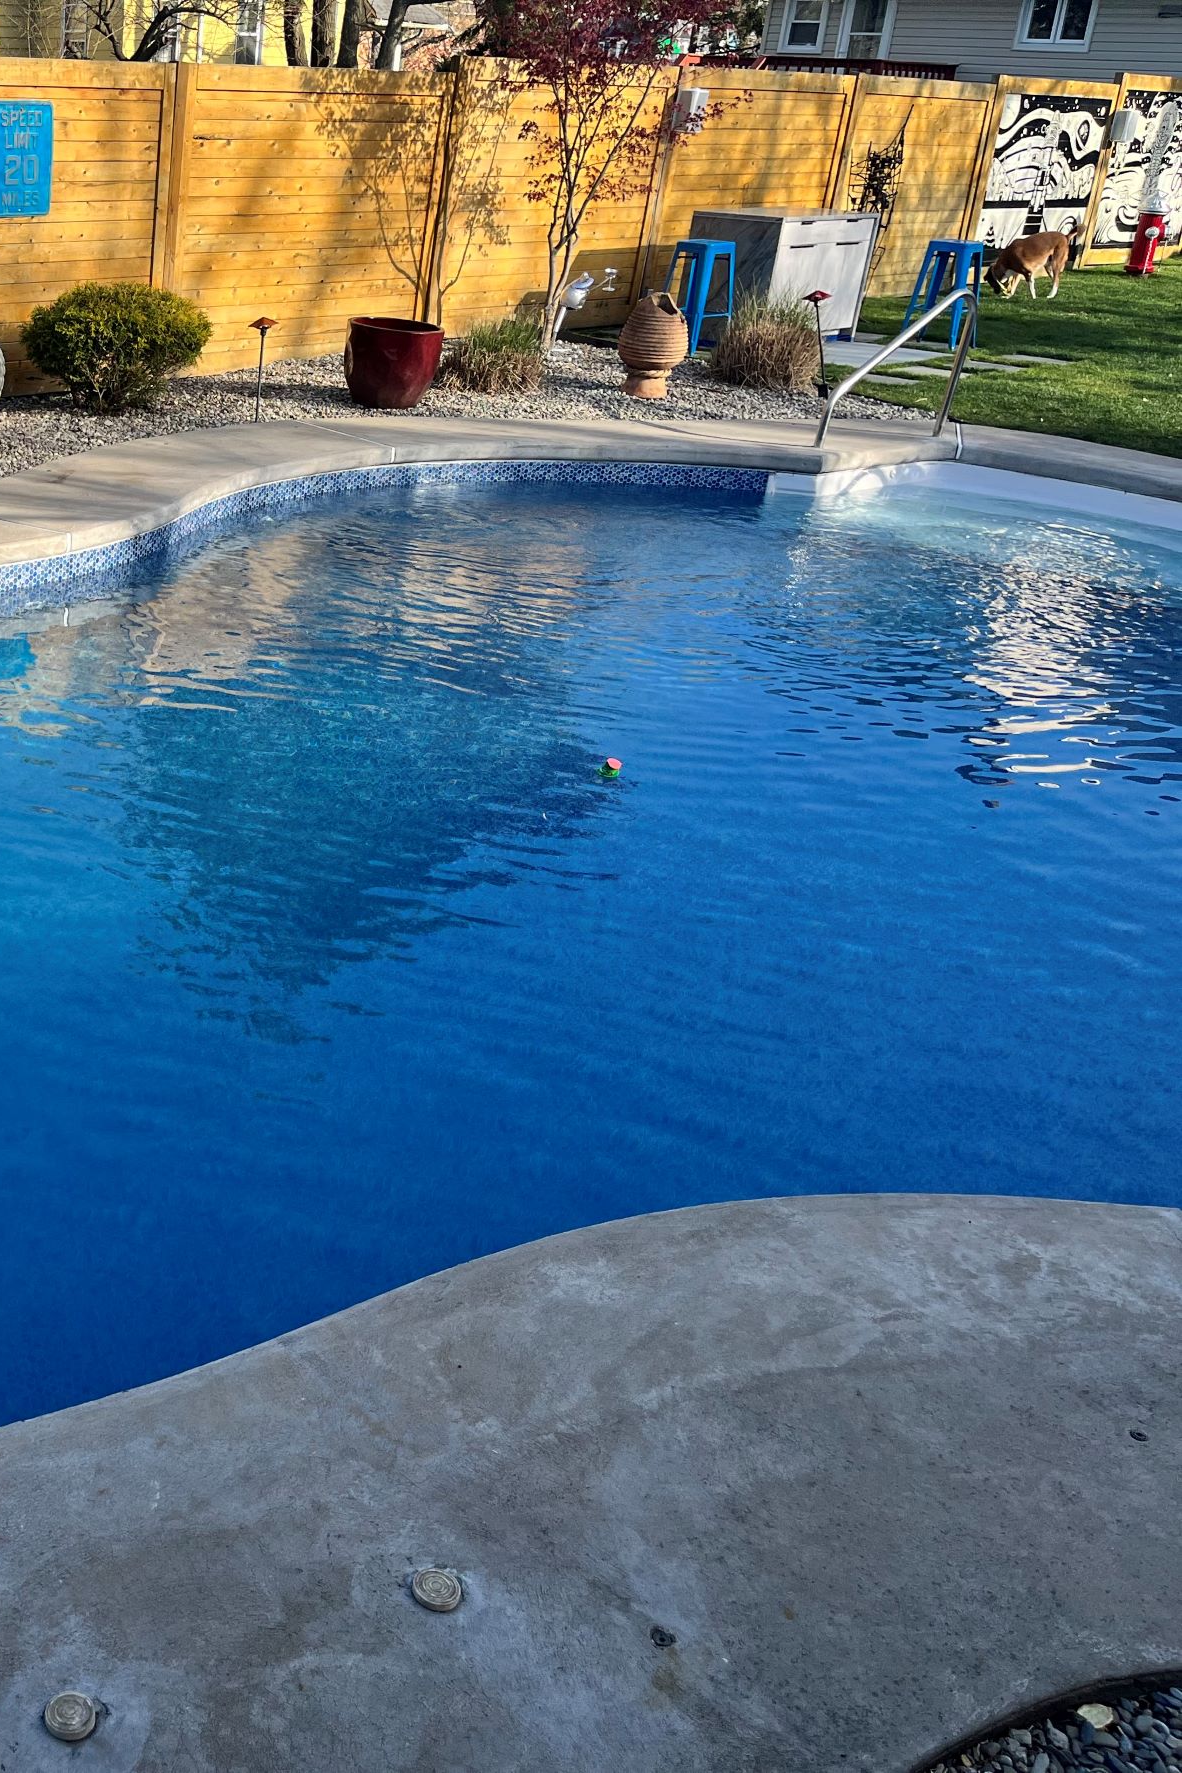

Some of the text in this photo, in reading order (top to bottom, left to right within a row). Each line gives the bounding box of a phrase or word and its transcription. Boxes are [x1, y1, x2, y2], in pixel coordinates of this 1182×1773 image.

[1, 109, 43, 127] SPEED
[5, 132, 39, 149] LIMIT
[4, 154, 39, 186] 20
[1, 190, 39, 207] MILES
